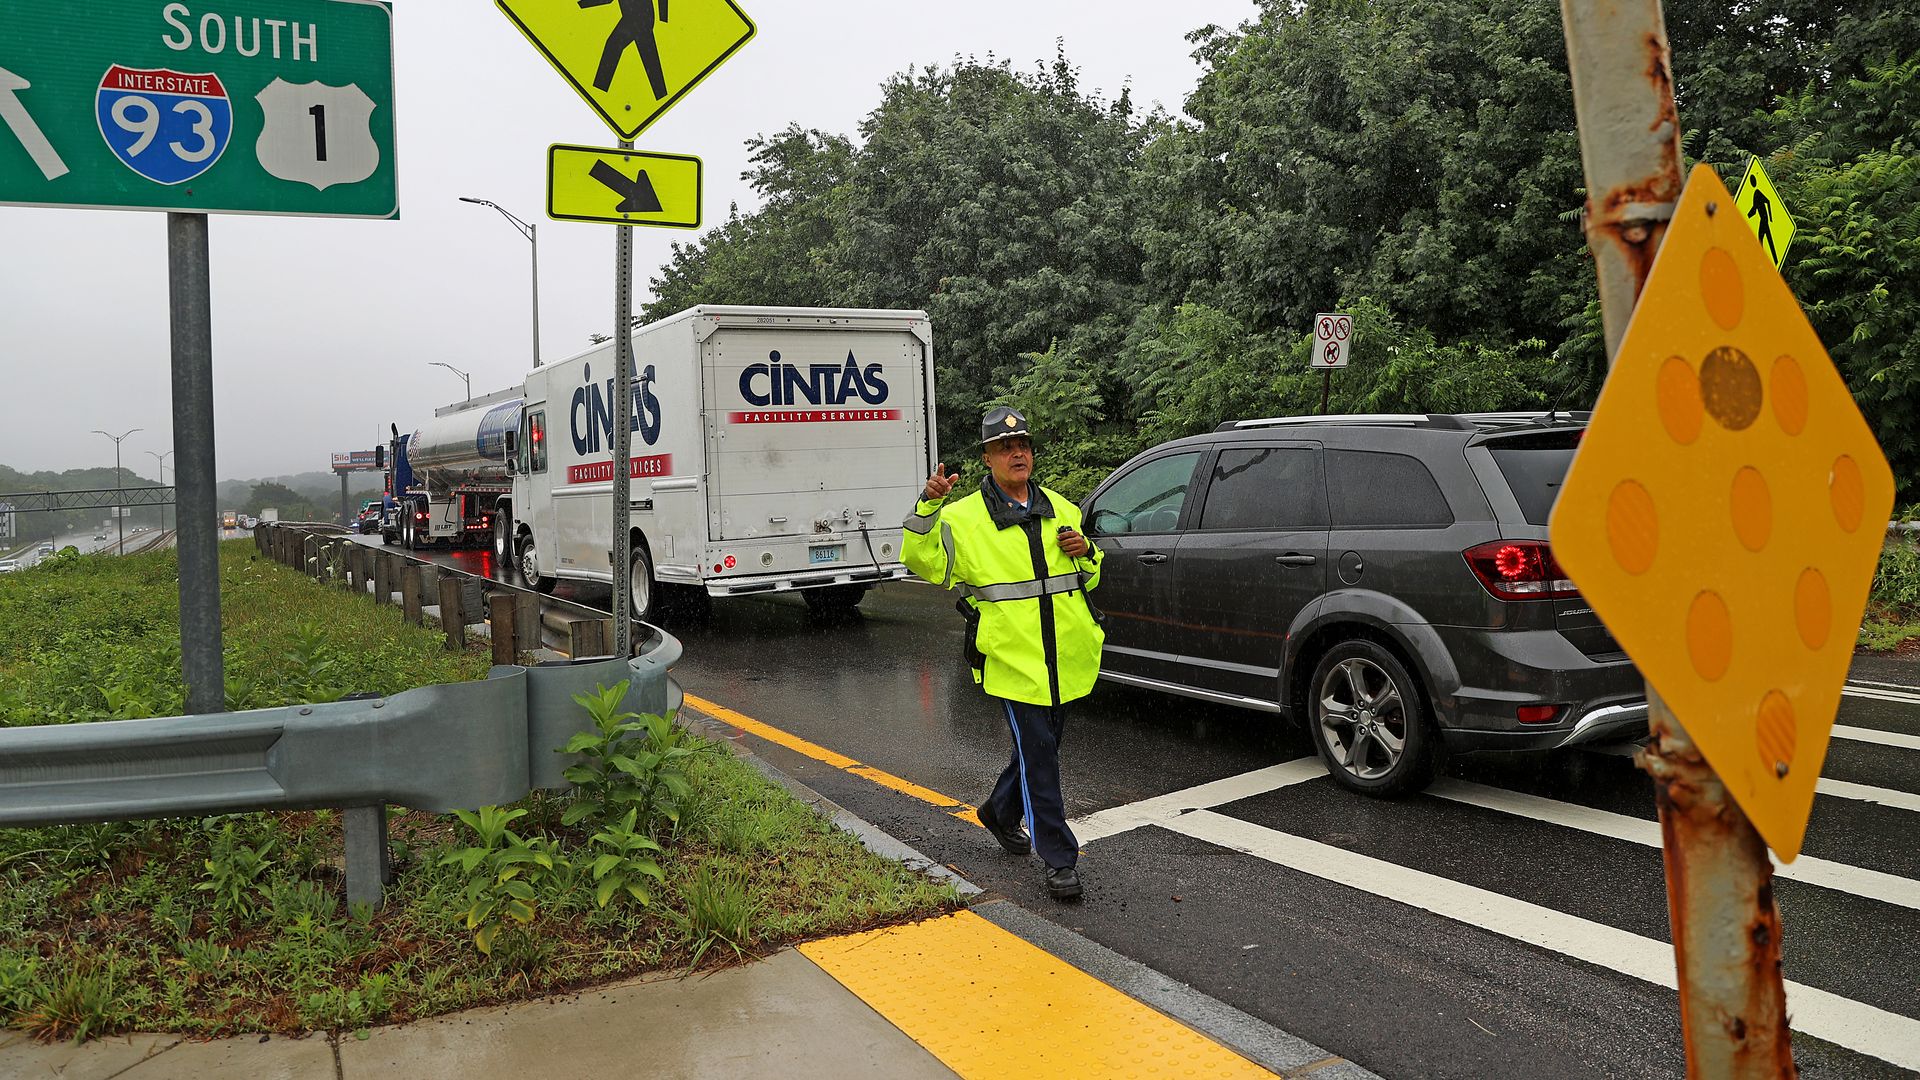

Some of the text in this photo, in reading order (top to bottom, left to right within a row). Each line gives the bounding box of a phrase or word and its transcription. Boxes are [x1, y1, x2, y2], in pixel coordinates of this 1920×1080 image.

[162, 3, 317, 62] SOUTH
[118, 73, 210, 95] INTERSTATE
[111, 96, 216, 163] 93
[309, 104, 327, 161] 1
[745, 411, 888, 421] FACILITY SERVICES
[574, 465, 611, 480] FACILITY
